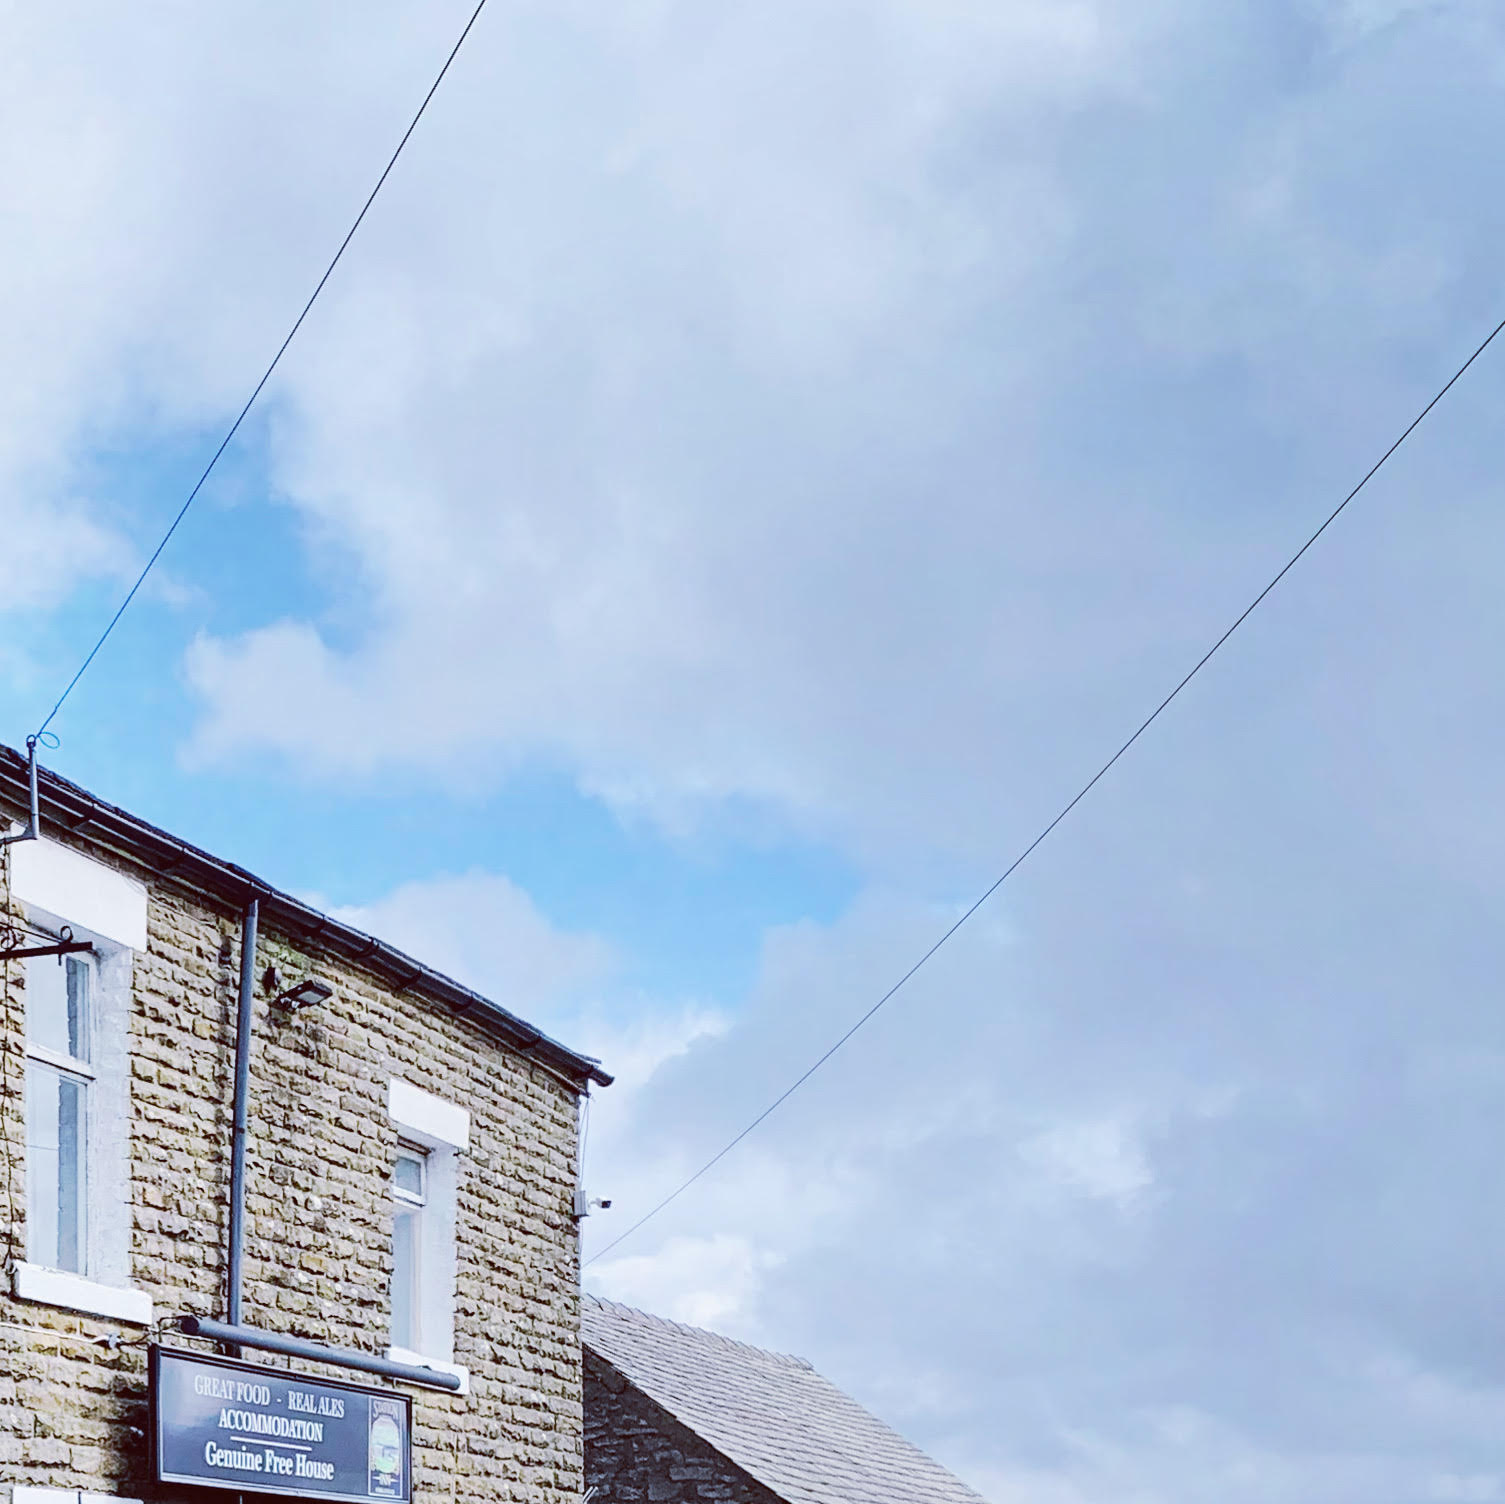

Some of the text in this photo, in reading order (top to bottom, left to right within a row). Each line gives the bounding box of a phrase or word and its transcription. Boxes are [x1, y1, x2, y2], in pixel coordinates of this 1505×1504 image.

[194, 1374, 236, 1401] GREAT
[237, 1383, 271, 1406] FOOD
[288, 1390, 317, 1415] REAL
[318, 1397, 345, 1419] ALES
[218, 1407, 324, 1442] ACCOMMODATION
[204, 1440, 335, 1482] Genuine Free House
